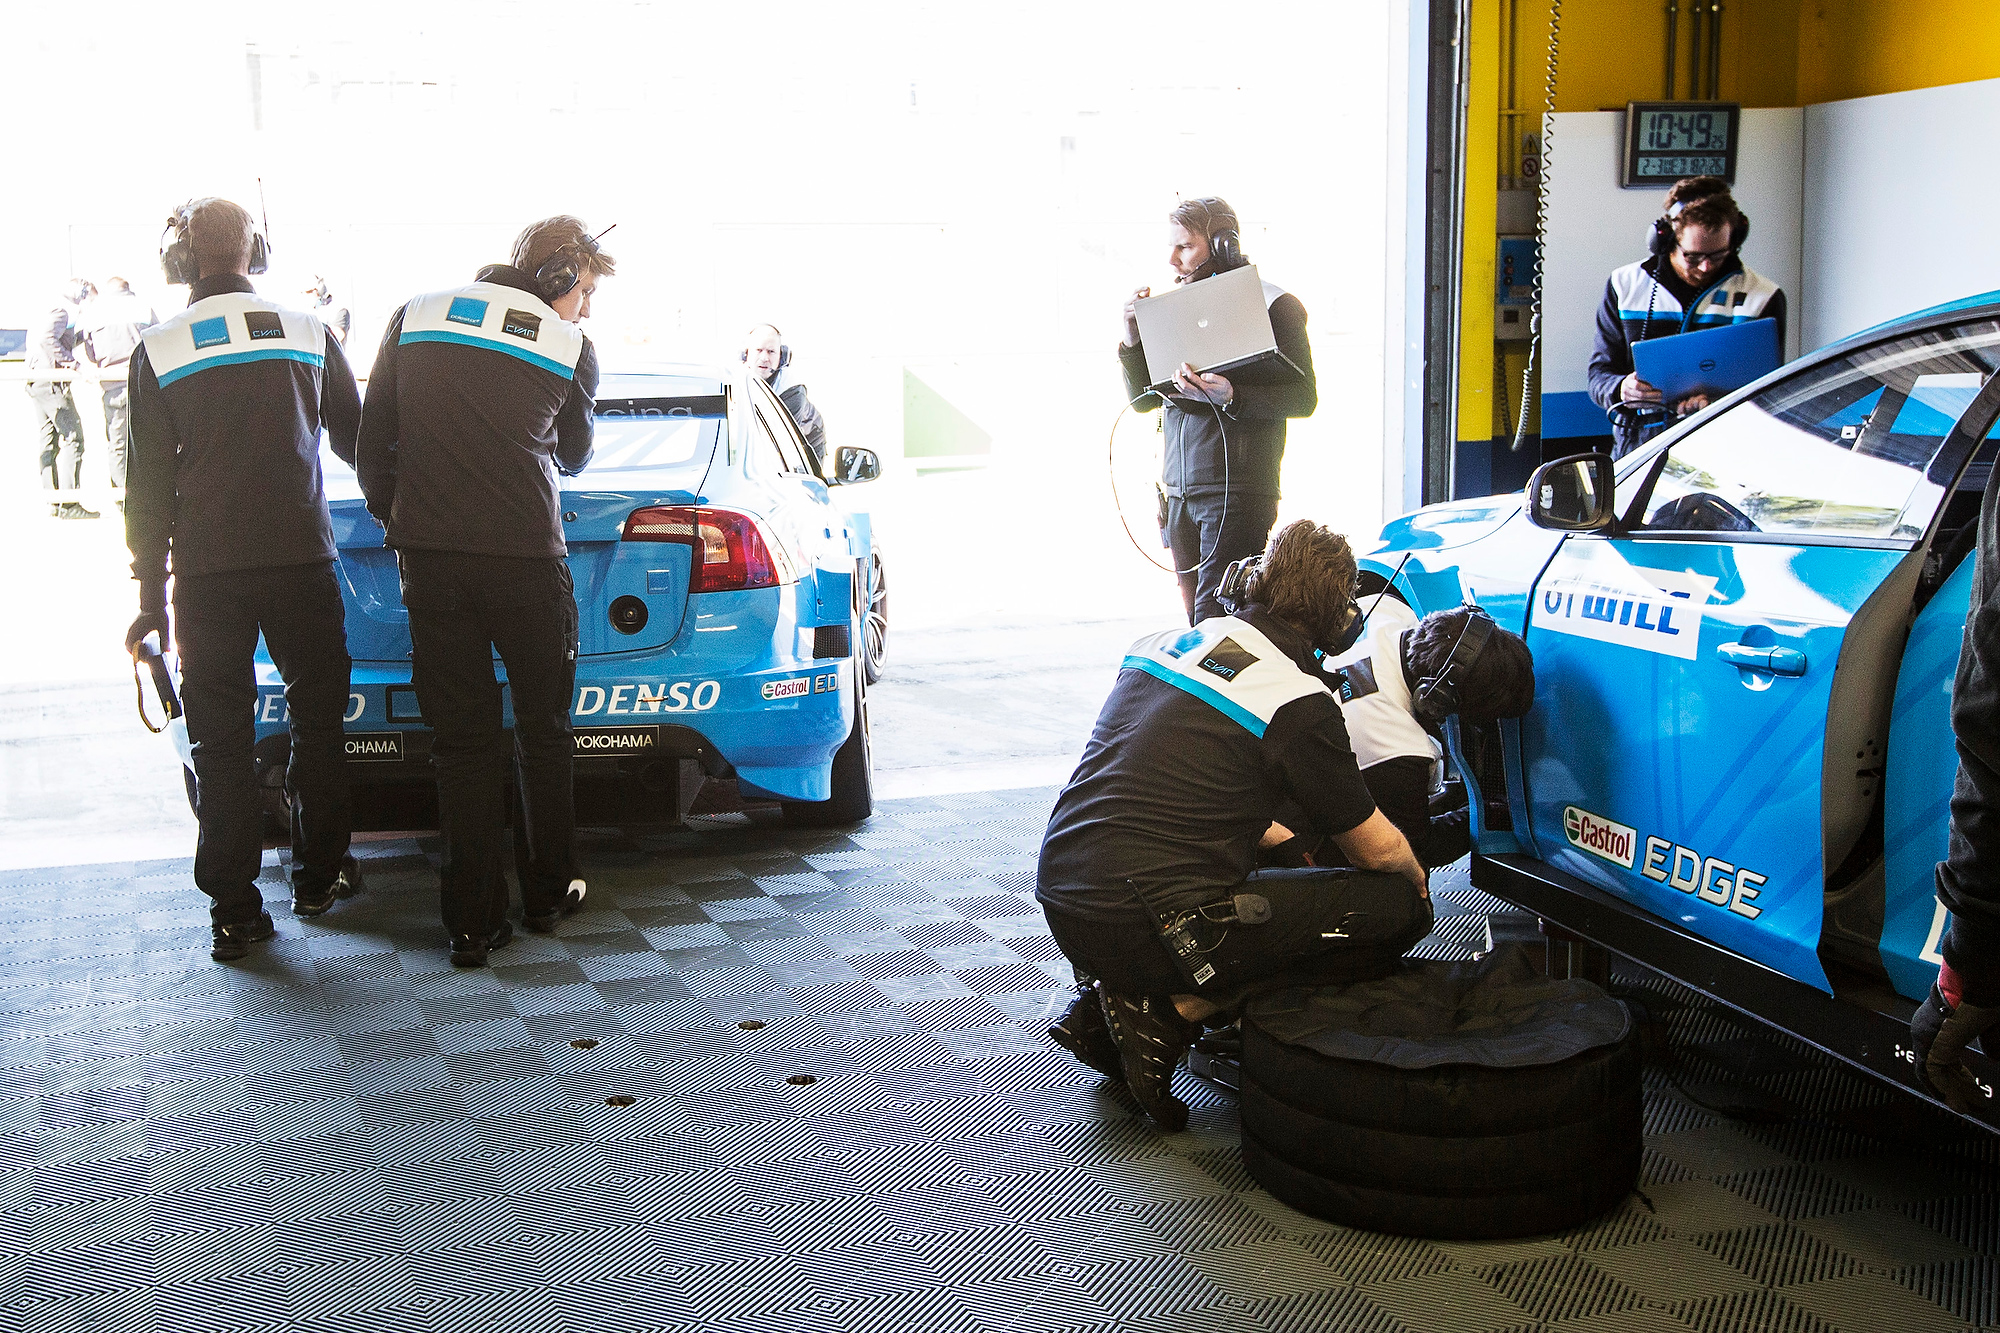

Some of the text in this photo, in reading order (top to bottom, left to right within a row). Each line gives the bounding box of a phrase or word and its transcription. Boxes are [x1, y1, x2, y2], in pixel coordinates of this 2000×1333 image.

[1648, 113, 1712, 149] 10:49
[575, 680, 721, 716] DENSO
[774, 673, 838, 697] Castrol ED
[344, 740, 398, 754] OHAMA
[573, 734, 654, 749] YOKOHAMA
[1580, 816, 1769, 920] Castrol EDGE
